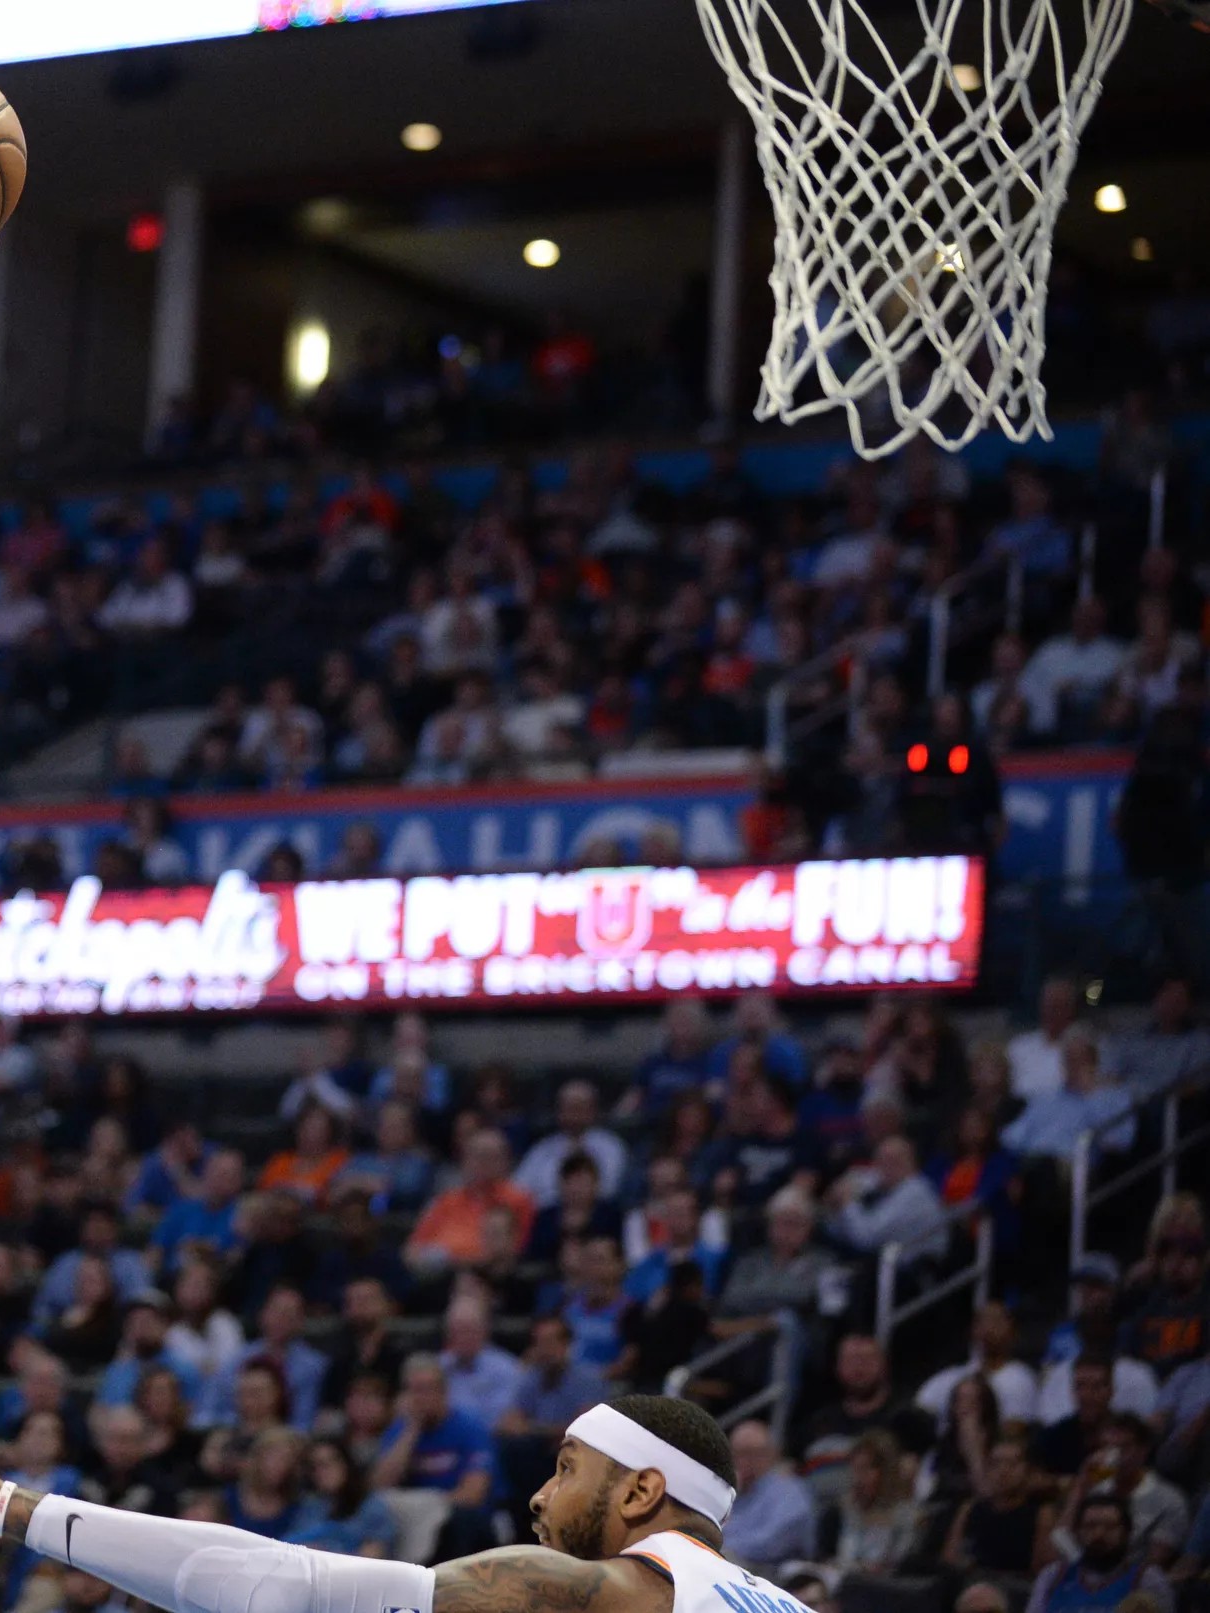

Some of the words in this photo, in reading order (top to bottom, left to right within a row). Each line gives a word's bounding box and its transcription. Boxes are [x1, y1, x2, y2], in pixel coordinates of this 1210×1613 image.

[294, 878, 402, 963] WE
[403, 873, 539, 959] PUT
[792, 855, 967, 946] FUN!
